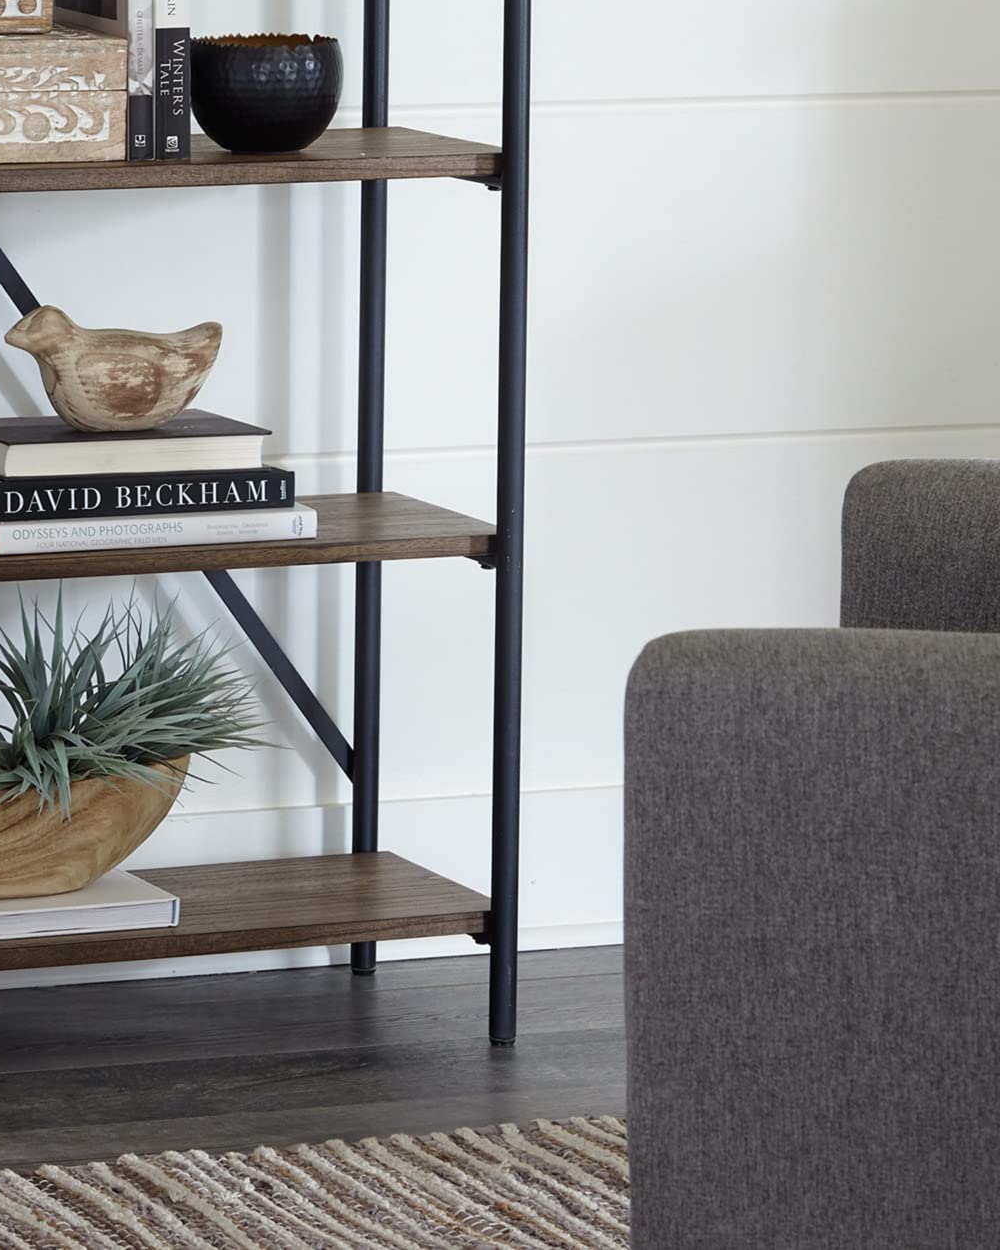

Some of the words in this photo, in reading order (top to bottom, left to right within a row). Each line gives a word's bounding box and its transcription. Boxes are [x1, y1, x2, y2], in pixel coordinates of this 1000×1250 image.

[160, 59, 172, 96] TALE
[172, 39, 186, 117] WINTER'S
[3, 488, 101, 514] DAVID
[115, 479, 269, 509] BECKHAM
[12, 526, 69, 541] ODYSSEYS
[71, 525, 97, 538] AND
[99, 521, 184, 537] PHOTOGRAPHS
